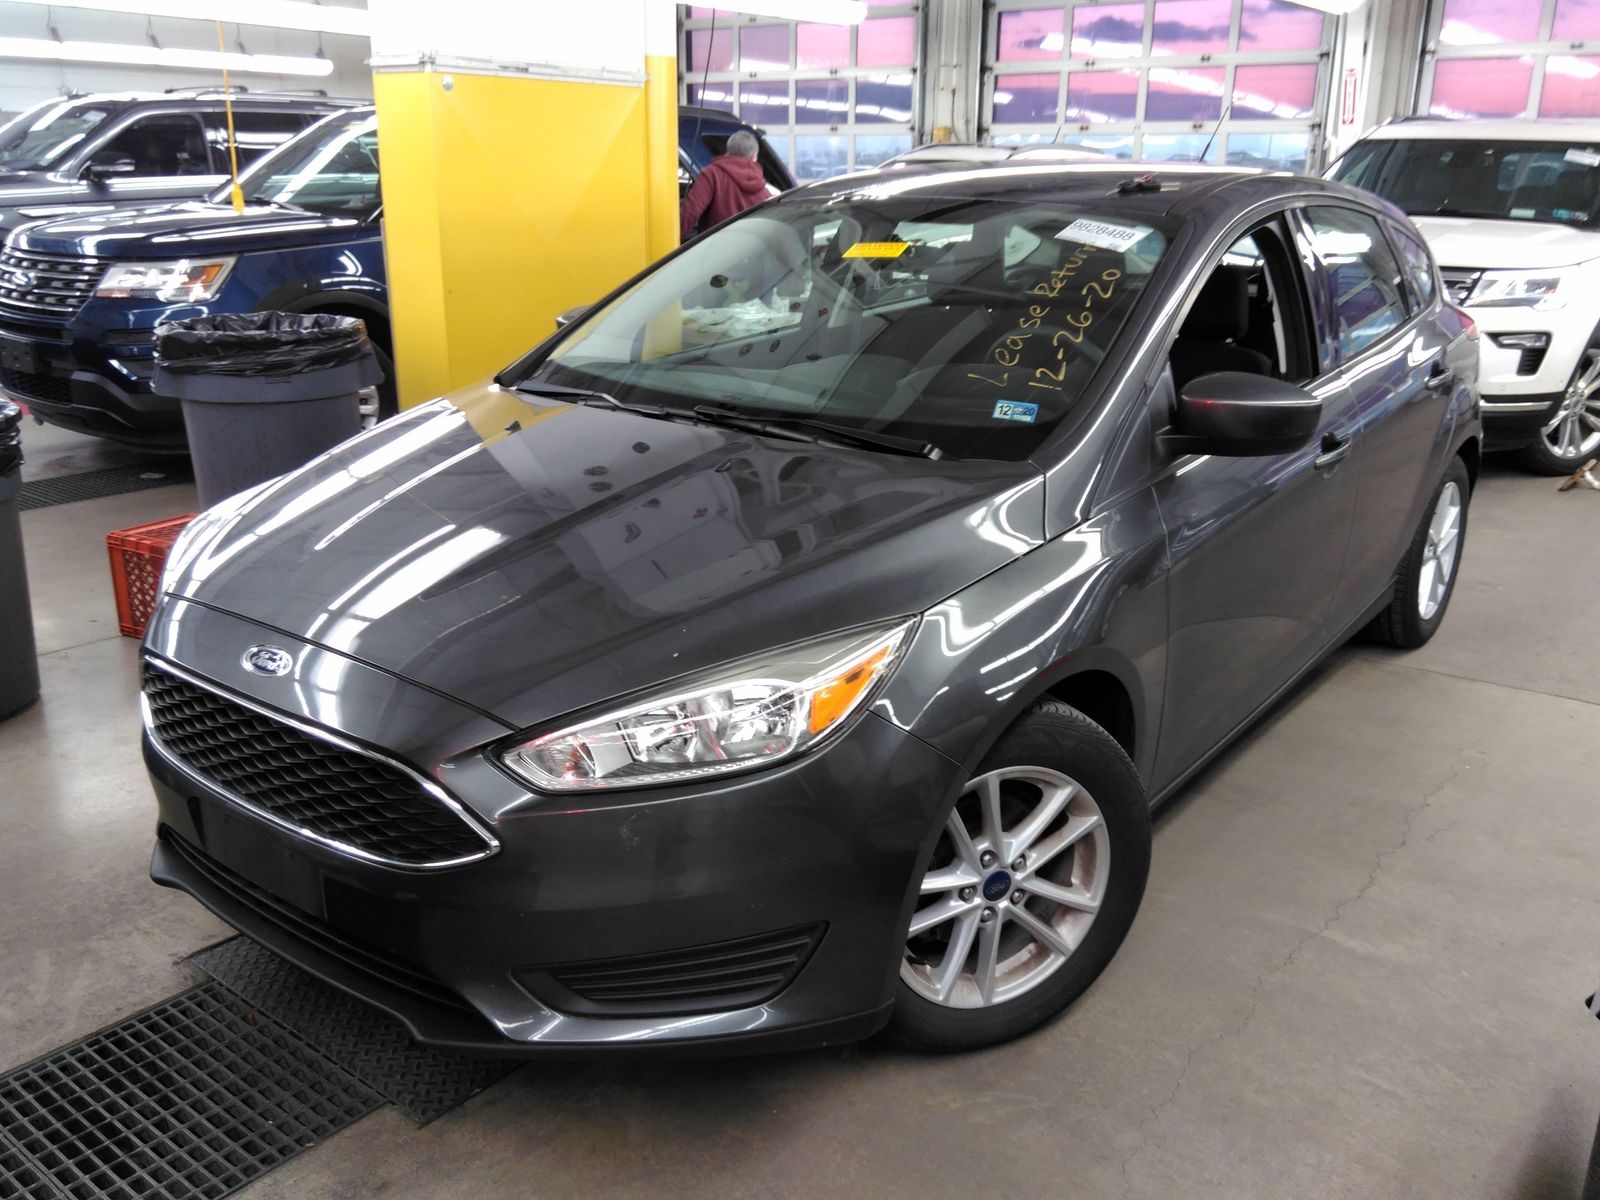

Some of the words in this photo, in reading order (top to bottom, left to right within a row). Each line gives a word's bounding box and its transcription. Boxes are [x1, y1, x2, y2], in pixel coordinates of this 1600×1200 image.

[1070, 221, 1136, 241] 9828488
[1028, 268, 1121, 391] 12-26-20
[967, 304, 1050, 387] Lease
[998, 404, 1012, 416] 12
[1022, 406, 1035, 416] 20
[250, 650, 287, 673] Ford
